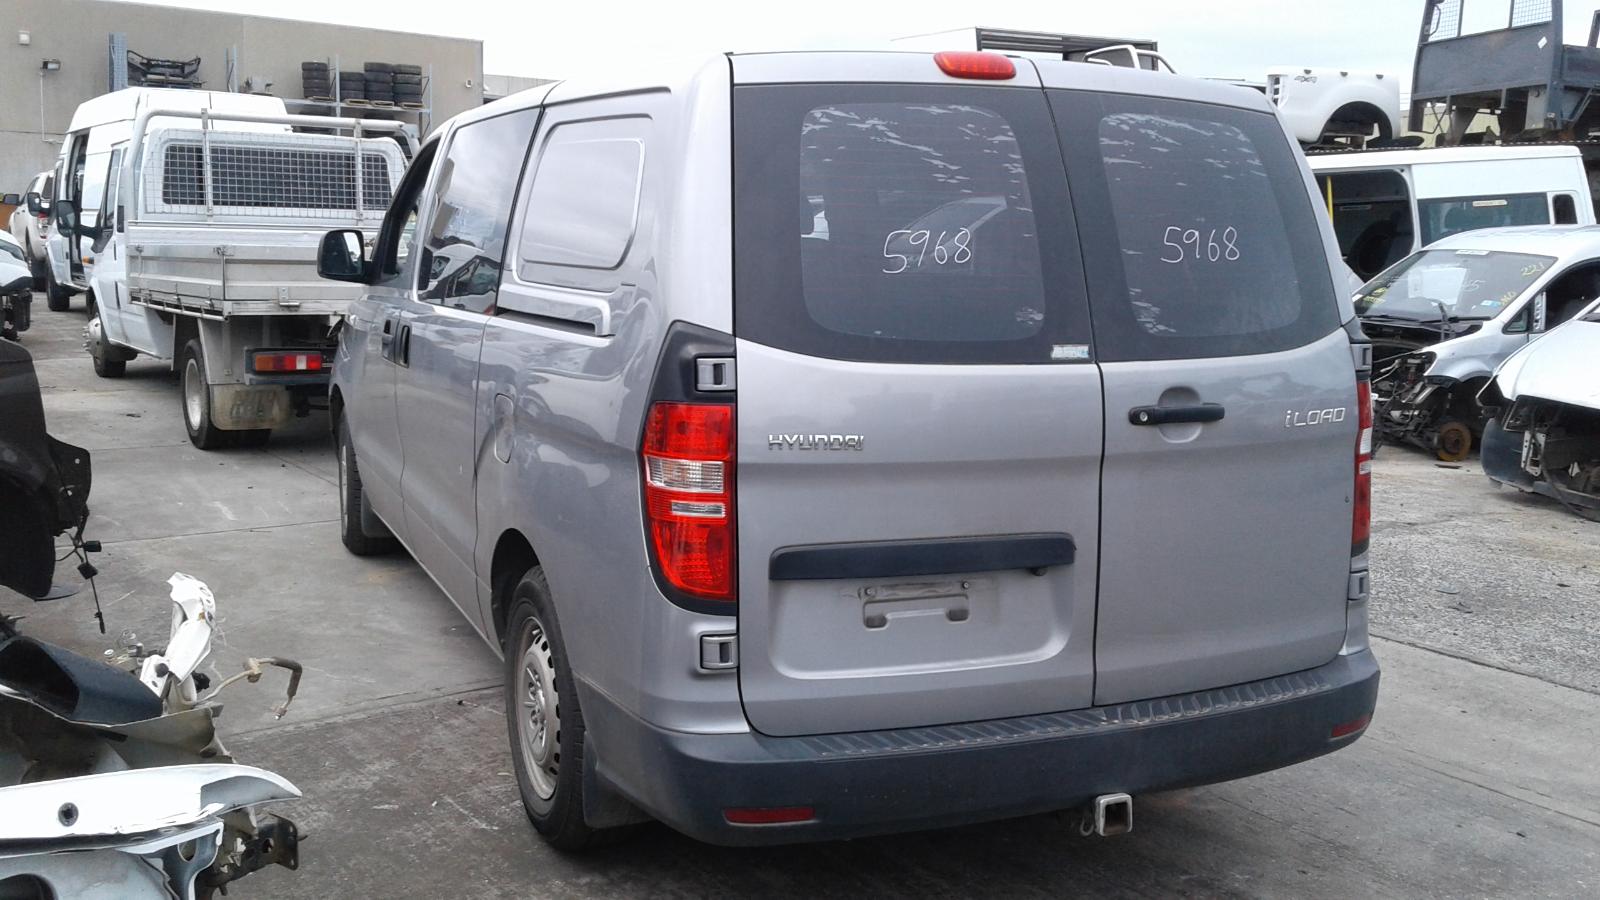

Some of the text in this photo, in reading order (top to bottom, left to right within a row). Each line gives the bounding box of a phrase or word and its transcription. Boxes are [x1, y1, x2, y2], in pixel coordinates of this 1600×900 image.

[882, 227, 972, 274] 5968
[1160, 225, 1240, 263] 5968
[767, 433, 865, 452] HYUNDAI
